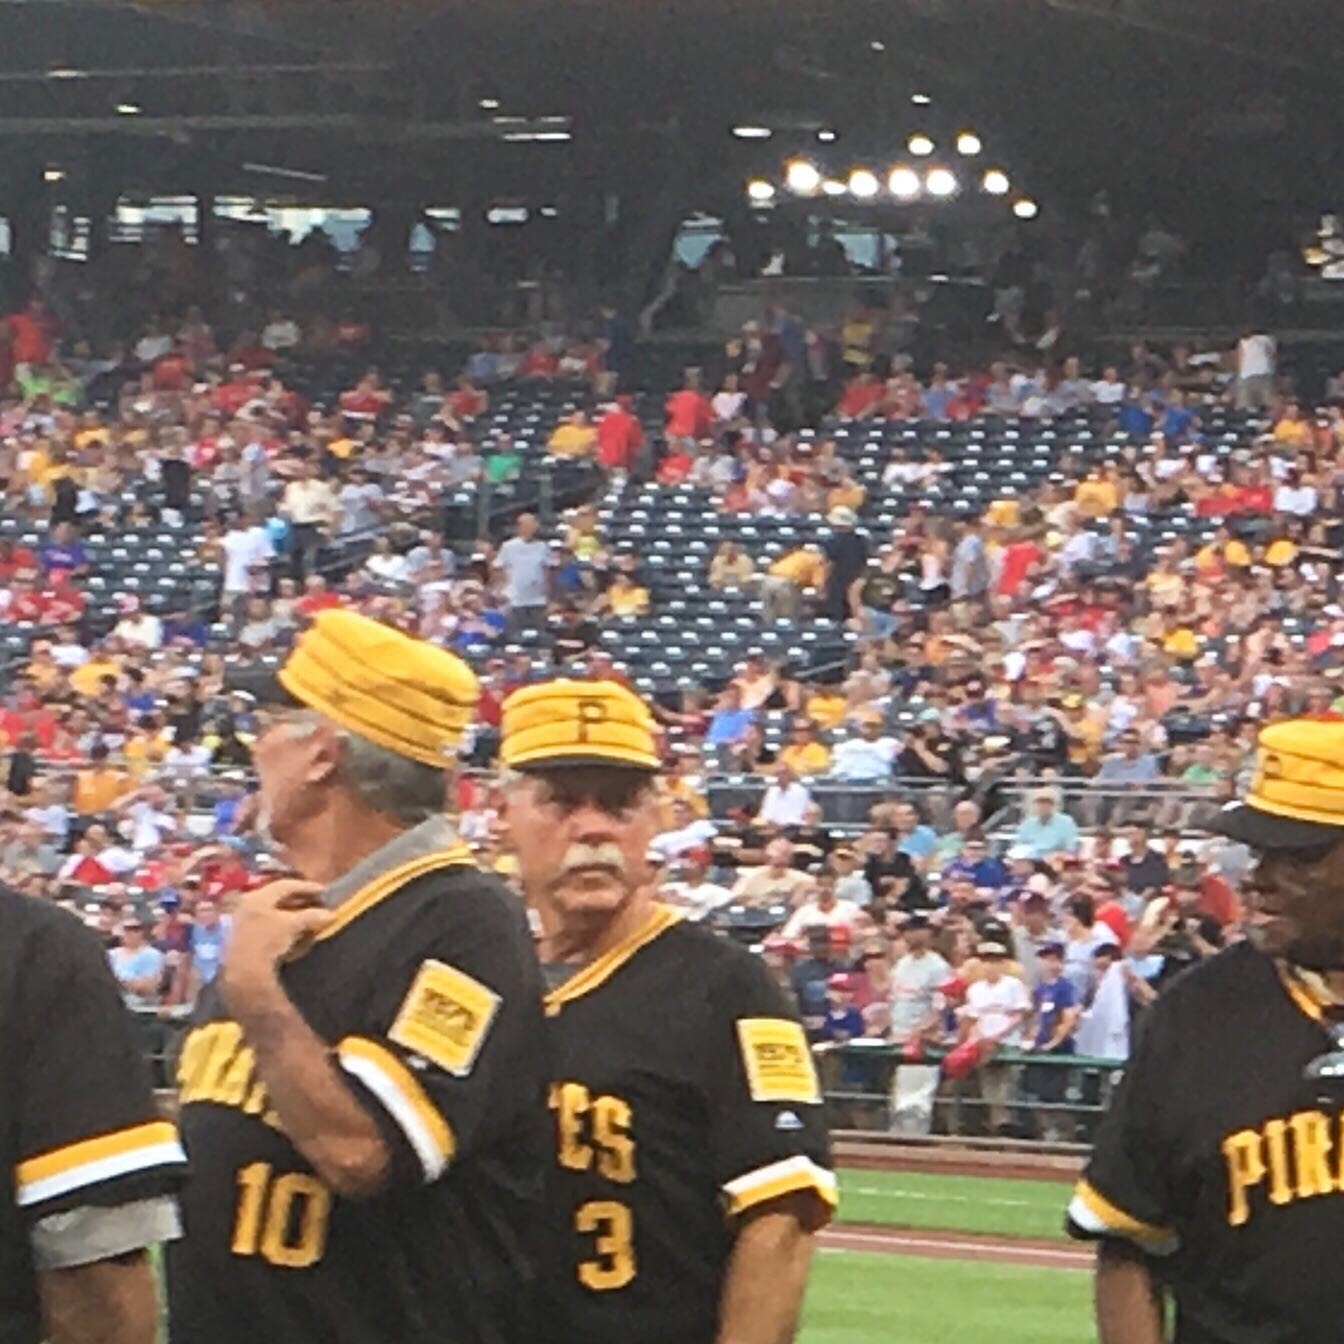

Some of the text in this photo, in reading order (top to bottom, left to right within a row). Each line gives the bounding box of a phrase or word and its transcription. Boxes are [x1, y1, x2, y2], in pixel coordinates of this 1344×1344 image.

[577, 699, 608, 745] P
[231, 1161, 332, 1269] 10
[574, 1199, 637, 1291] 3
